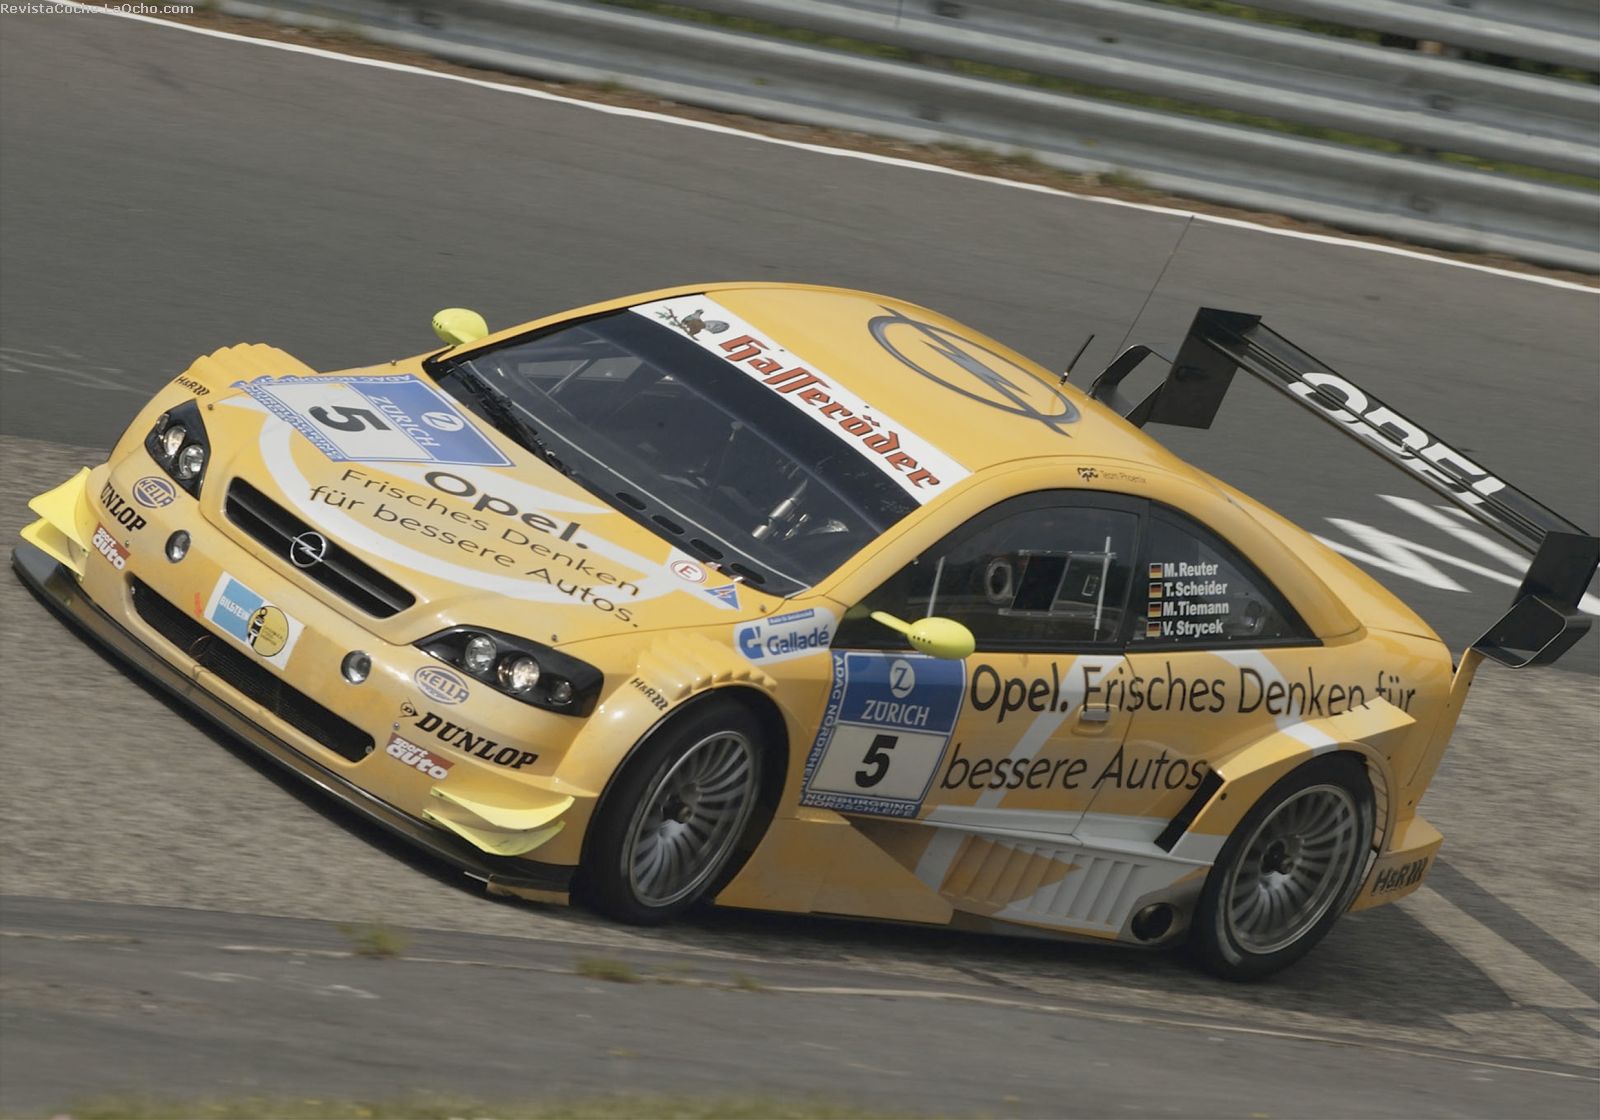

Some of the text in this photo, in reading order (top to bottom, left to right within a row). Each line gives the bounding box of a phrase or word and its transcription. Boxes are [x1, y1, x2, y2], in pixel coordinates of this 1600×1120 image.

[308, 405, 393, 432] 5
[1288, 372, 1506, 504] OPEL
[101, 481, 147, 532] UNLOP
[139, 480, 174, 508] HELLA
[424, 471, 589, 549] Opel.
[93, 533, 126, 570] auto
[310, 486, 639, 628] für bessere Autos.
[341, 468, 640, 597] Frisches Denken
[767, 624, 829, 656] Galladé
[419, 670, 470, 703] HELLA
[833, 654, 844, 700] ADAC
[970, 662, 1068, 722] Opel.
[1082, 661, 1226, 714] Frisches
[1237, 667, 1368, 718] Denken
[386, 743, 448, 780] auto
[414, 711, 538, 770] DUNLOP
[855, 734, 899, 788] 5
[940, 743, 1207, 791] bessere Autos
